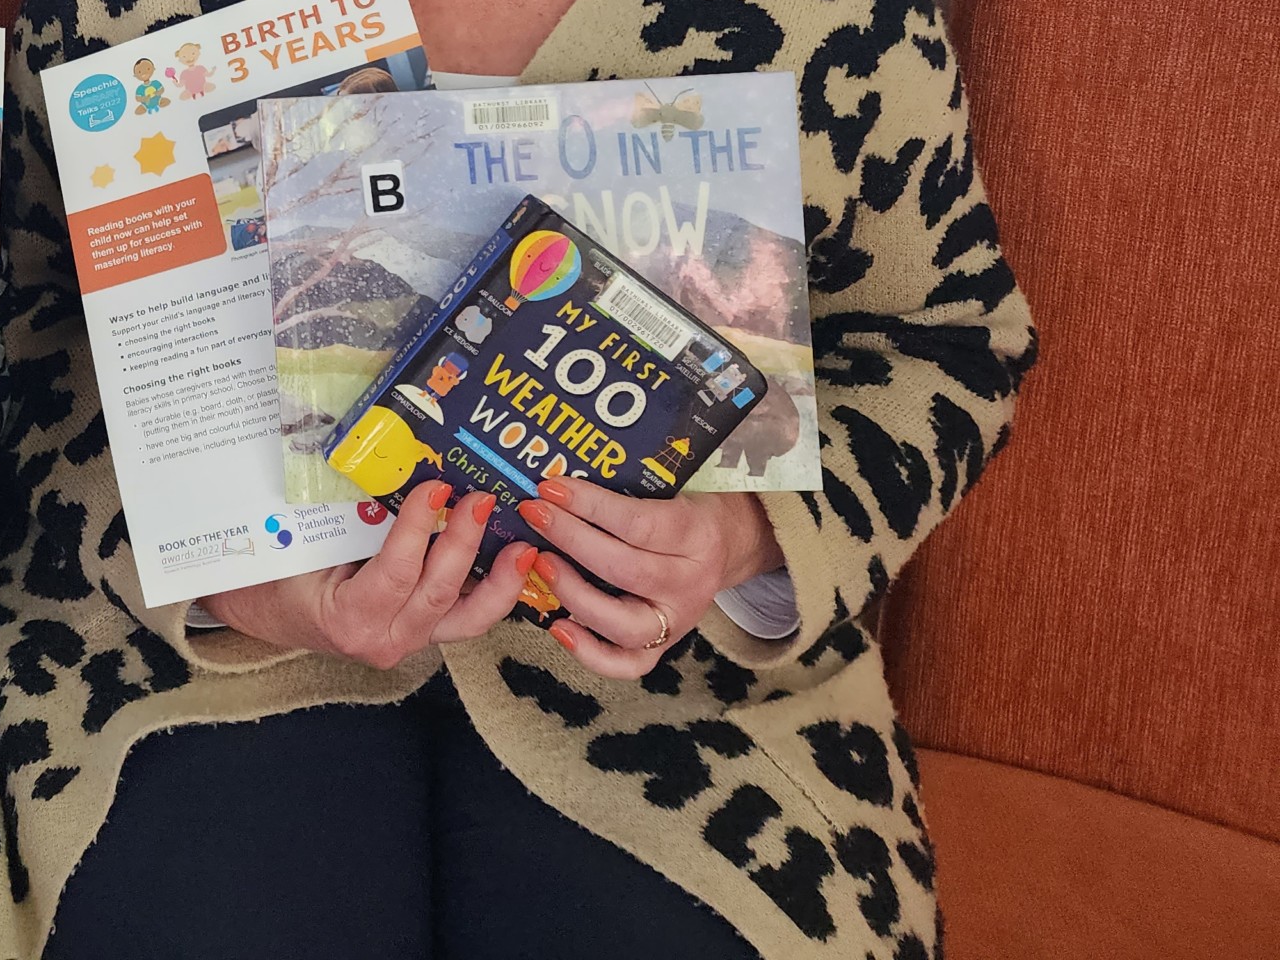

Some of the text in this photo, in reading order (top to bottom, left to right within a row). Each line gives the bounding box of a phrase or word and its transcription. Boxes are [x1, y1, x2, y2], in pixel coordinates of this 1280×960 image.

[220, 5, 322, 55] BIRTH
[227, 12, 386, 83] 3 YEARS
[73, 80, 118, 98] Speechie
[78, 98, 120, 116] Talks 2022
[472, 101, 511, 109] BATHURST
[478, 121, 544, 131] 01/002966092
[454, 114, 765, 185] THE O IN THE
[369, 174, 405, 214] B
[87, 197, 197, 236] Reading books with your
[90, 212, 188, 248] child now can help set
[91, 220, 203, 259] them success with
[94, 242, 175, 271] mastering literacy.
[593, 261, 612, 278] BLADE
[108, 312, 134, 324] Ways
[148, 303, 168, 314] help
[170, 294, 194, 307] build
[196, 282, 240, 300] language
[242, 276, 260, 287] and
[111, 289, 265, 337] Support your child's language and literacy
[488, 296, 514, 317] BALLOON
[124, 316, 216, 347] choosing the right books
[127, 329, 219, 359] encouraging interactions
[556, 300, 671, 391] MY FIRST
[130, 328, 272, 372] keeping reading part everyday
[123, 358, 242, 395] Choosing the right books
[125, 397, 150, 408] Babies
[151, 392, 174, 401] whose
[176, 380, 213, 395] caregivers
[214, 375, 230, 385] read
[232, 371, 247, 380] with
[248, 365, 267, 377] them
[523, 323, 647, 428] 100
[674, 363, 701, 385] SATELLITE
[127, 406, 153, 418] literacy
[154, 400, 171, 410] skills
[181, 392, 208, 405] primary
[237, 377, 266, 389] Choose
[390, 391, 427, 421] CLIMATOLOGY
[155, 412, 181, 425] durable
[171, 404, 244, 430] them their mouth)
[483, 353, 627, 479] WEATHER
[691, 414, 718, 435] MESONET
[146, 440, 163, 451] have
[209, 420, 241, 434] colourful
[242, 416, 267, 427] picture
[203, 437, 236, 450] including
[237, 430, 267, 442] textured
[447, 447, 489, 483] Chris
[642, 469, 666, 489] WEATHER
[294, 503, 330, 519] Speech
[297, 514, 347, 532] Pathology
[158, 525, 250, 553] BOOK OF THE YEAR
[302, 526, 347, 544] Australia
[489, 520, 515, 542] Scott
[161, 551, 195, 566] awards
[197, 545, 219, 558] 2022
